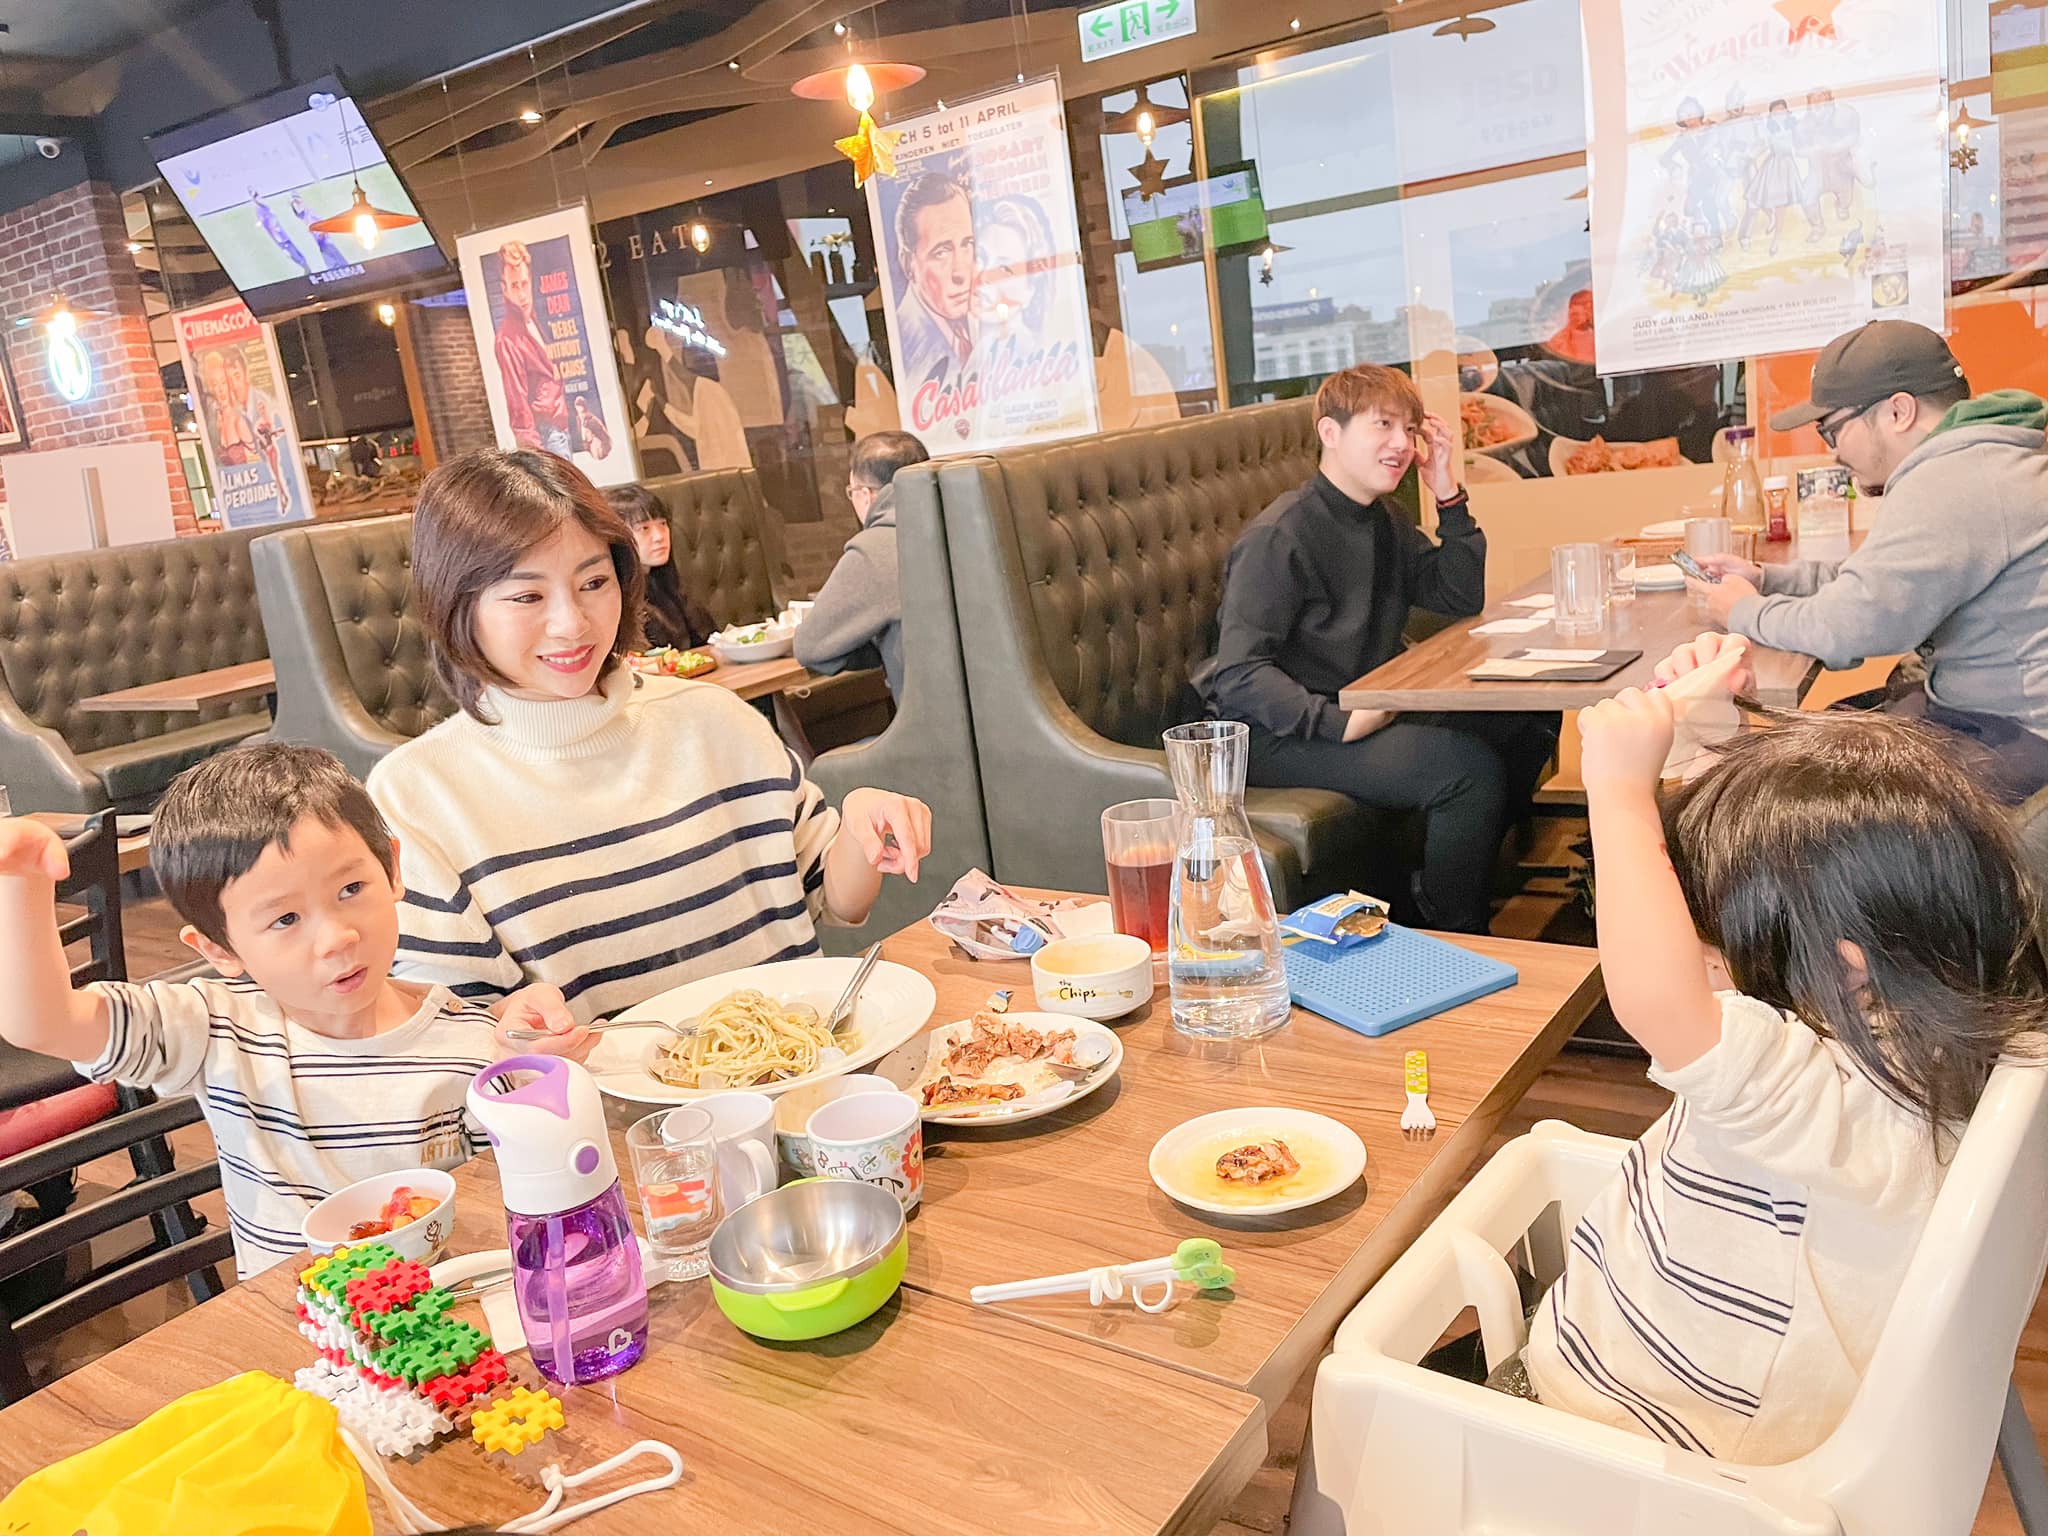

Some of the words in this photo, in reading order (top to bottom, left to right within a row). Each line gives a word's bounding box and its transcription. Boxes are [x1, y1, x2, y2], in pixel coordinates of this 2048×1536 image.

[1087, 39, 1114, 53] EXIT
[896, 130, 918, 147] CH
[923, 126, 932, 138] 5
[938, 122, 953, 135] tot
[960, 116, 970, 129] 11
[977, 102, 1021, 125] APRIL
[628, 223, 689, 260] EAT
[546, 293, 571, 314] DEAN
[1632, 319, 1658, 331] JUDY
[1660, 311, 1710, 327] GARLAND
[912, 338, 1080, 432] Casablanca
[221, 467, 259, 492] ALMAS
[225, 481, 278, 508] PERDIDAS
[1059, 986, 1097, 1004] Chips
